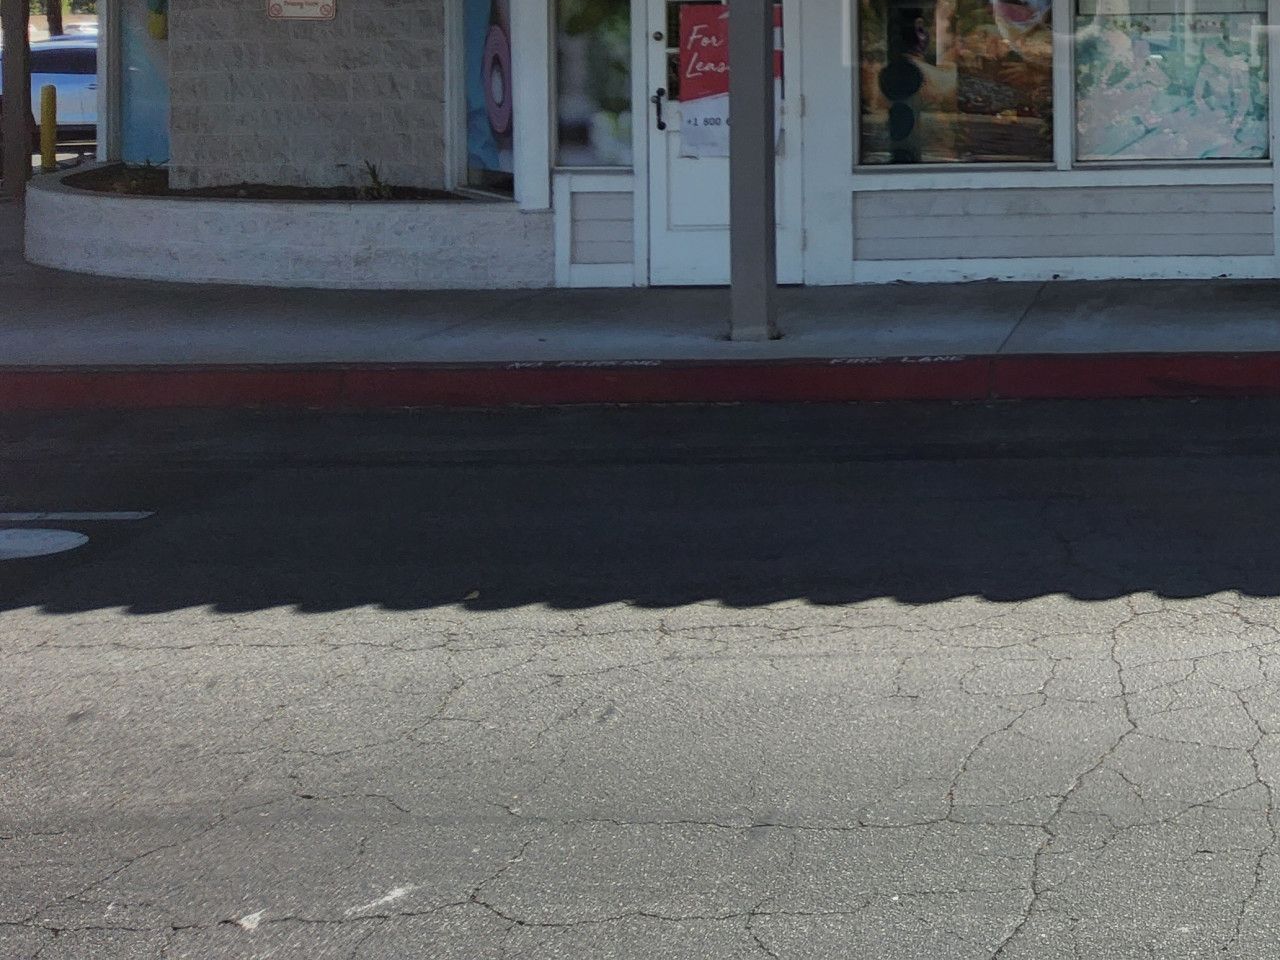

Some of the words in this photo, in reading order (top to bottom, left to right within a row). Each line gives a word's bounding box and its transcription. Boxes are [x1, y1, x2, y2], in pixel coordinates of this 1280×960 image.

[687, 24, 722, 50] For
[686, 52, 731, 78] Leas
[687, 117, 699, 127] +1
[703, 117, 722, 127] 800
